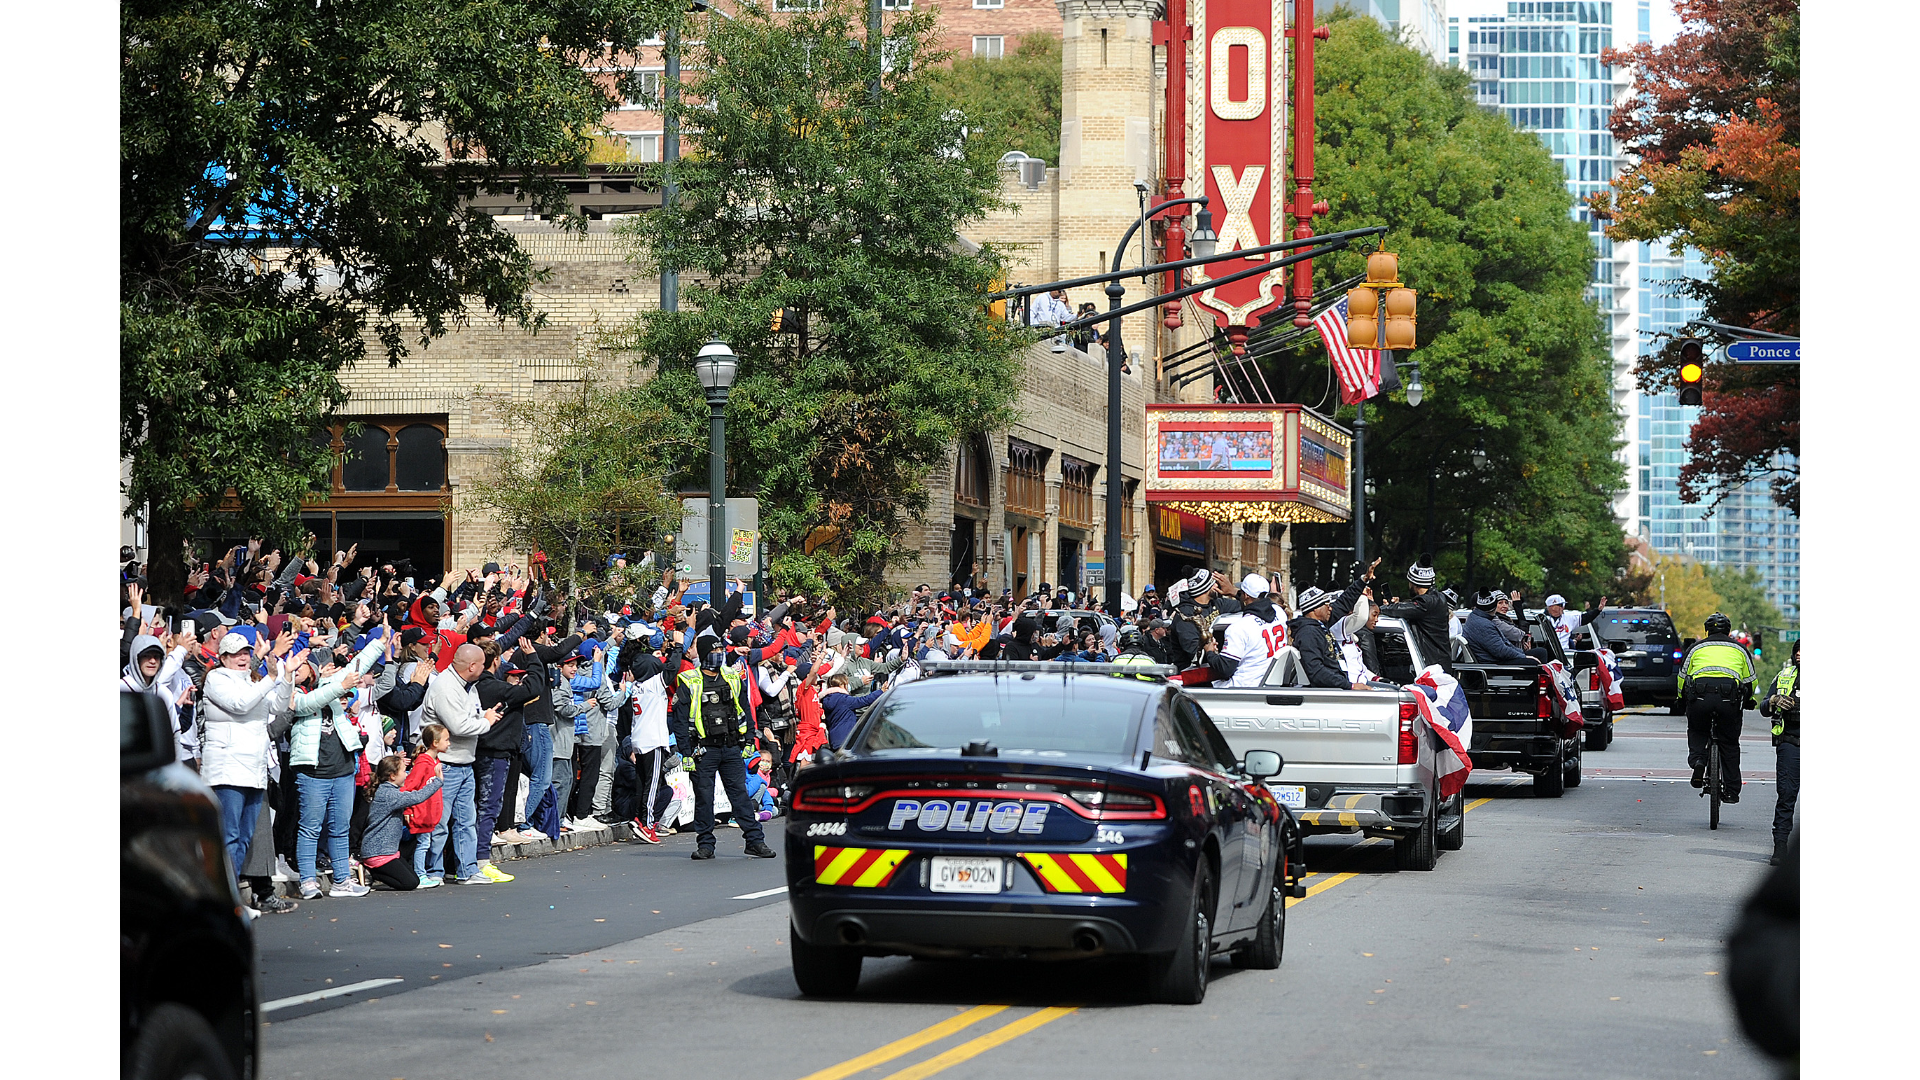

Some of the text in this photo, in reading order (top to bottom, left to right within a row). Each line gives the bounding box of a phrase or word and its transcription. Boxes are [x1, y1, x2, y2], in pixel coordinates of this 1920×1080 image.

[1749, 345, 1791, 358] Ponce
[1262, 624, 1286, 658] 12
[1211, 716, 1383, 732] HEVROLET
[887, 799, 1050, 834] POLICE
